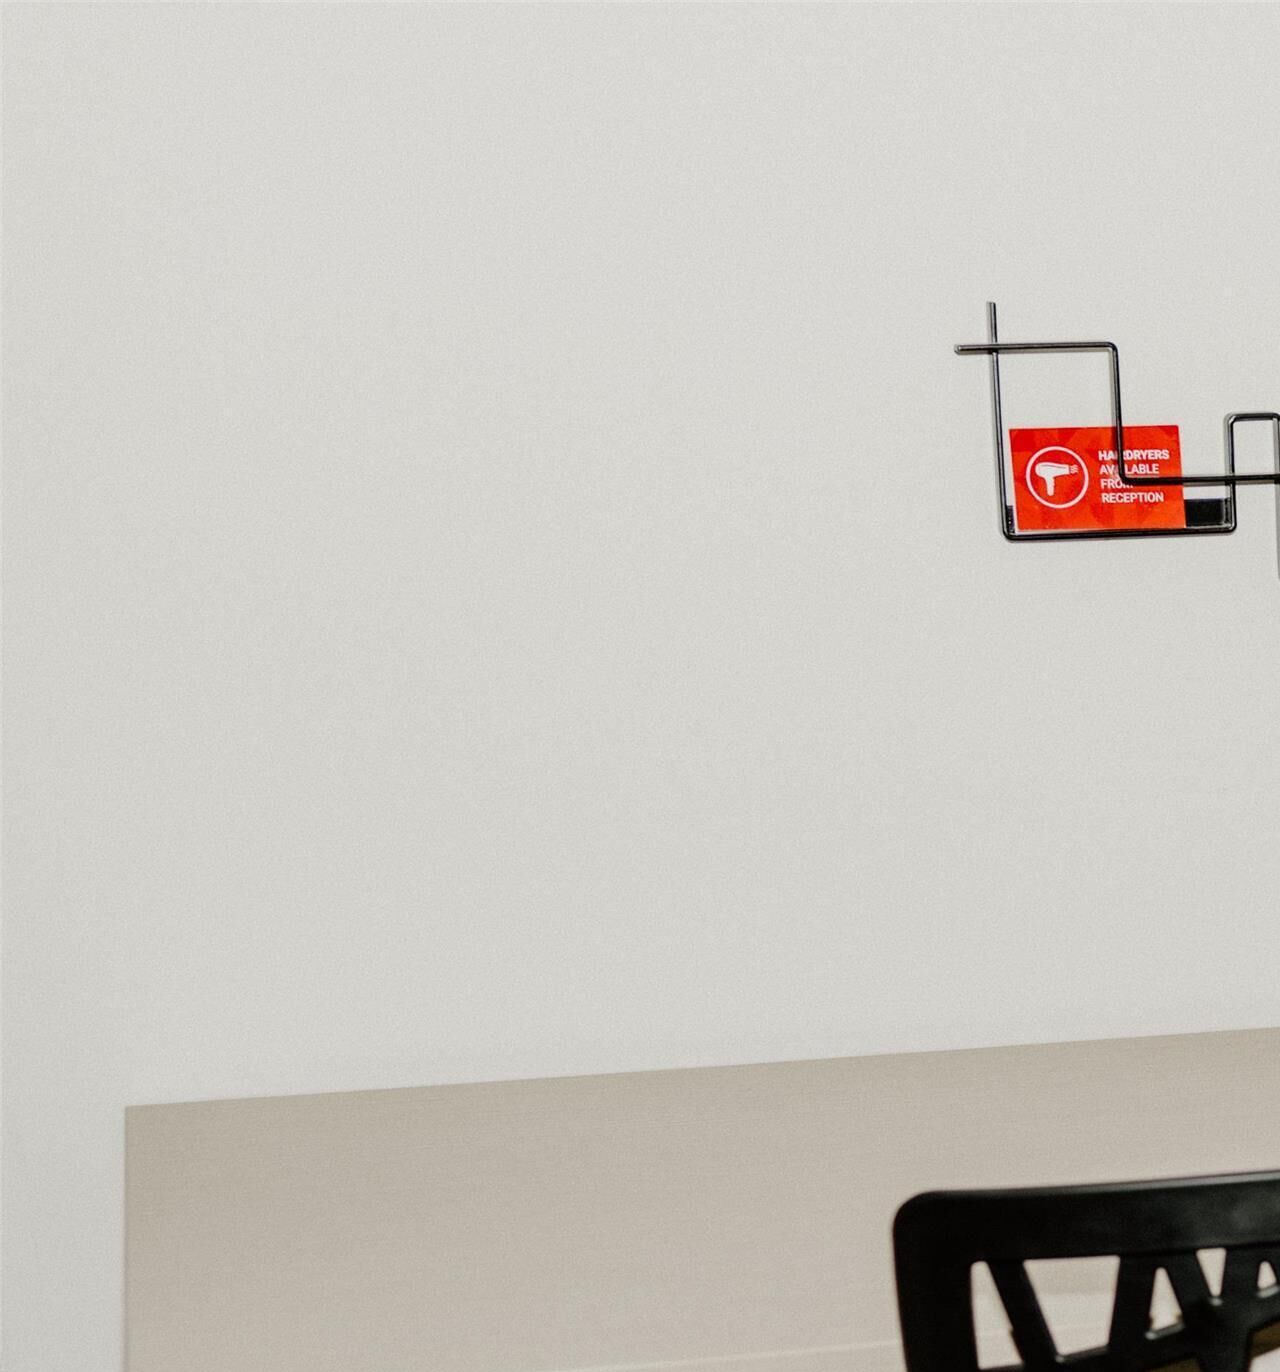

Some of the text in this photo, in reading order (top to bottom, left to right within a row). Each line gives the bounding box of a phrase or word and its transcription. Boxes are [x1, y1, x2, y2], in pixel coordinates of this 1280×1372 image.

[1098, 448, 1170, 461] HAIDRYERS
[1099, 463, 1160, 475] AVLABLE
[1102, 491, 1164, 503] RECEPTION
